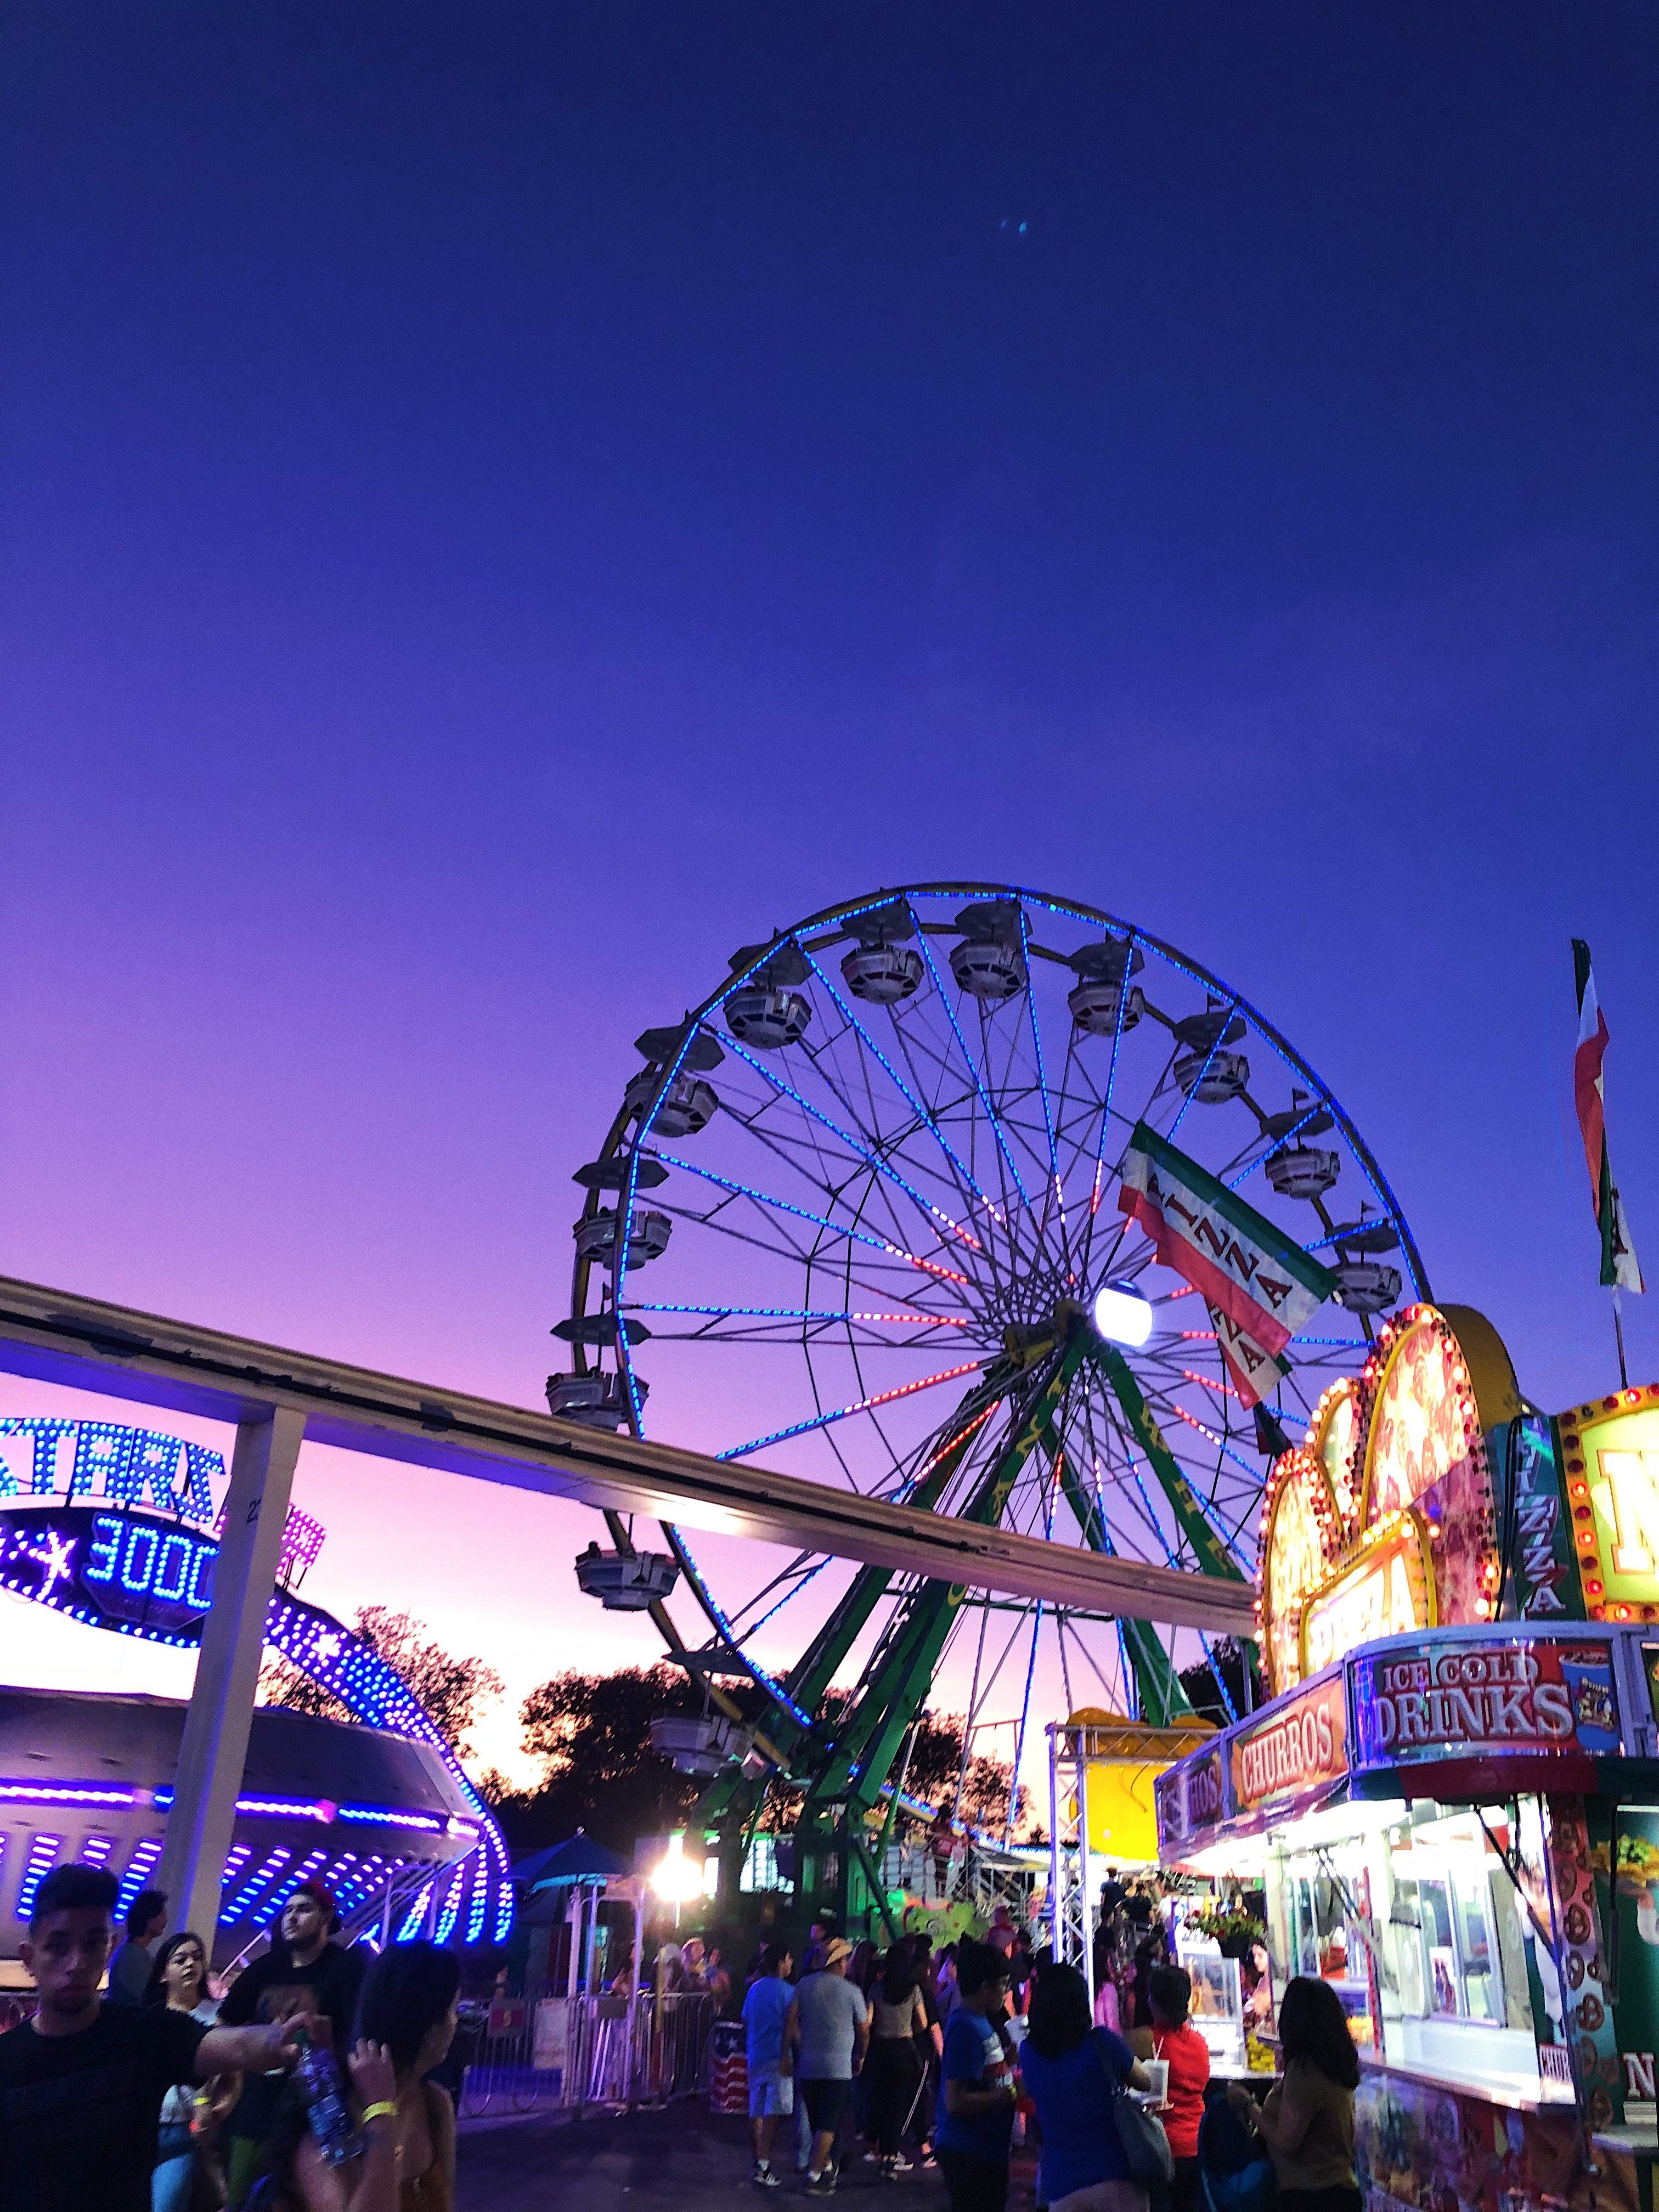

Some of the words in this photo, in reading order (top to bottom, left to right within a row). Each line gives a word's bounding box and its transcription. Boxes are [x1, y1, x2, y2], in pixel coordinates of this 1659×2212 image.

[1383, 1663, 1428, 1692] ICE
[1438, 1653, 1538, 1687] COLD
[1376, 1684, 1575, 1744] DRINKS
[1242, 1703, 1333, 1797] CHURROS
